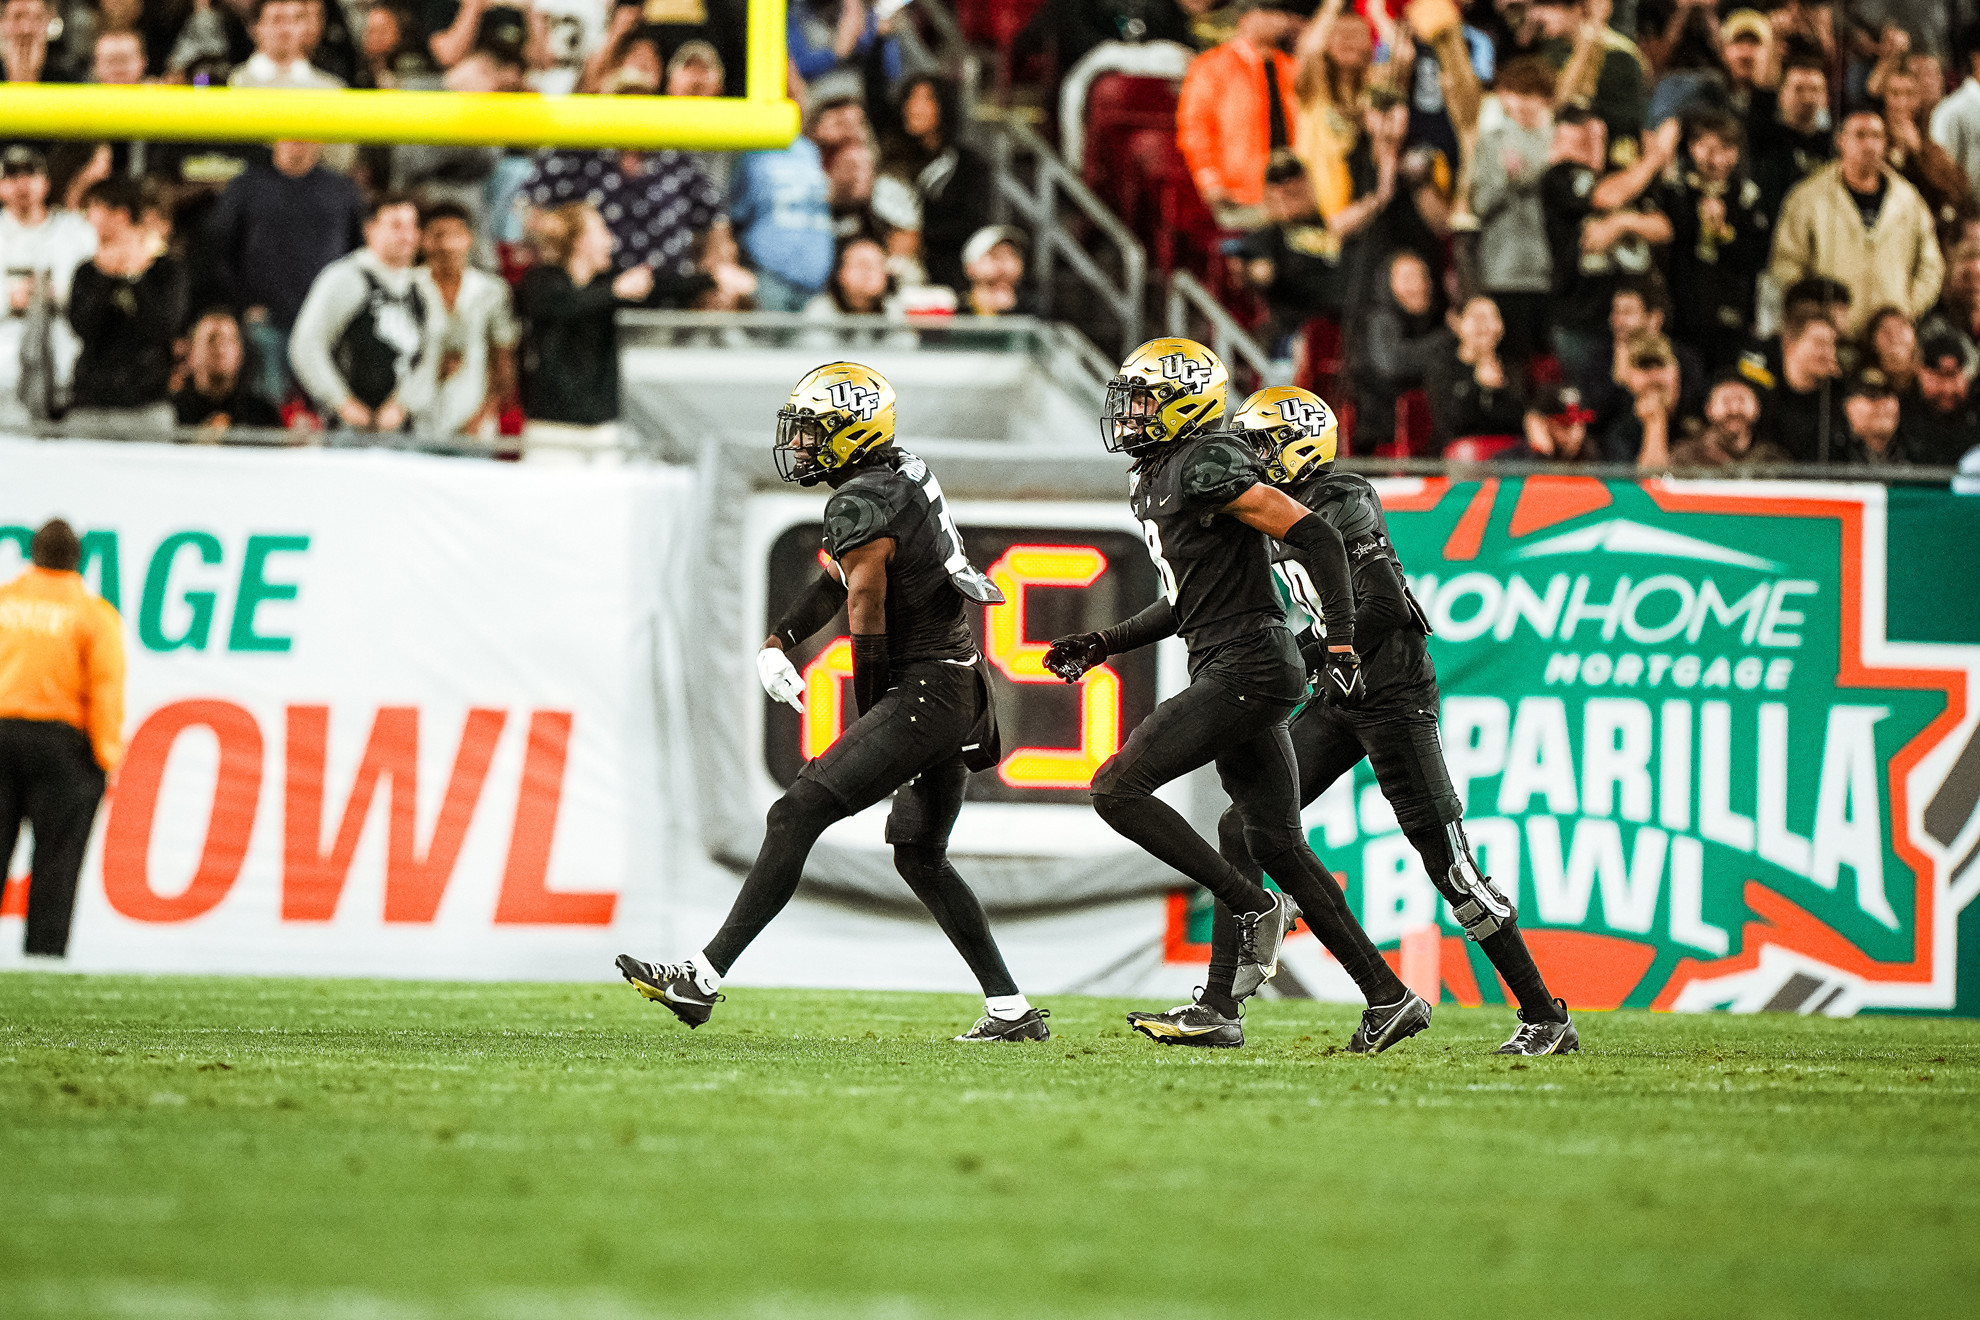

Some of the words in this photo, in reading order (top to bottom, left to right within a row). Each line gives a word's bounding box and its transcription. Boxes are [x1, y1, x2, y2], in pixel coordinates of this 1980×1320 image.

[1158, 352, 1211, 394] UCF
[826, 380, 879, 422] UCF
[1275, 397, 1327, 436] UCF
[1404, 572, 1819, 647] IONHOME
[1544, 653, 1793, 690] MORTGAGE
[0, 698, 619, 926] OWL
[1300, 695, 1901, 932] PARILLA
